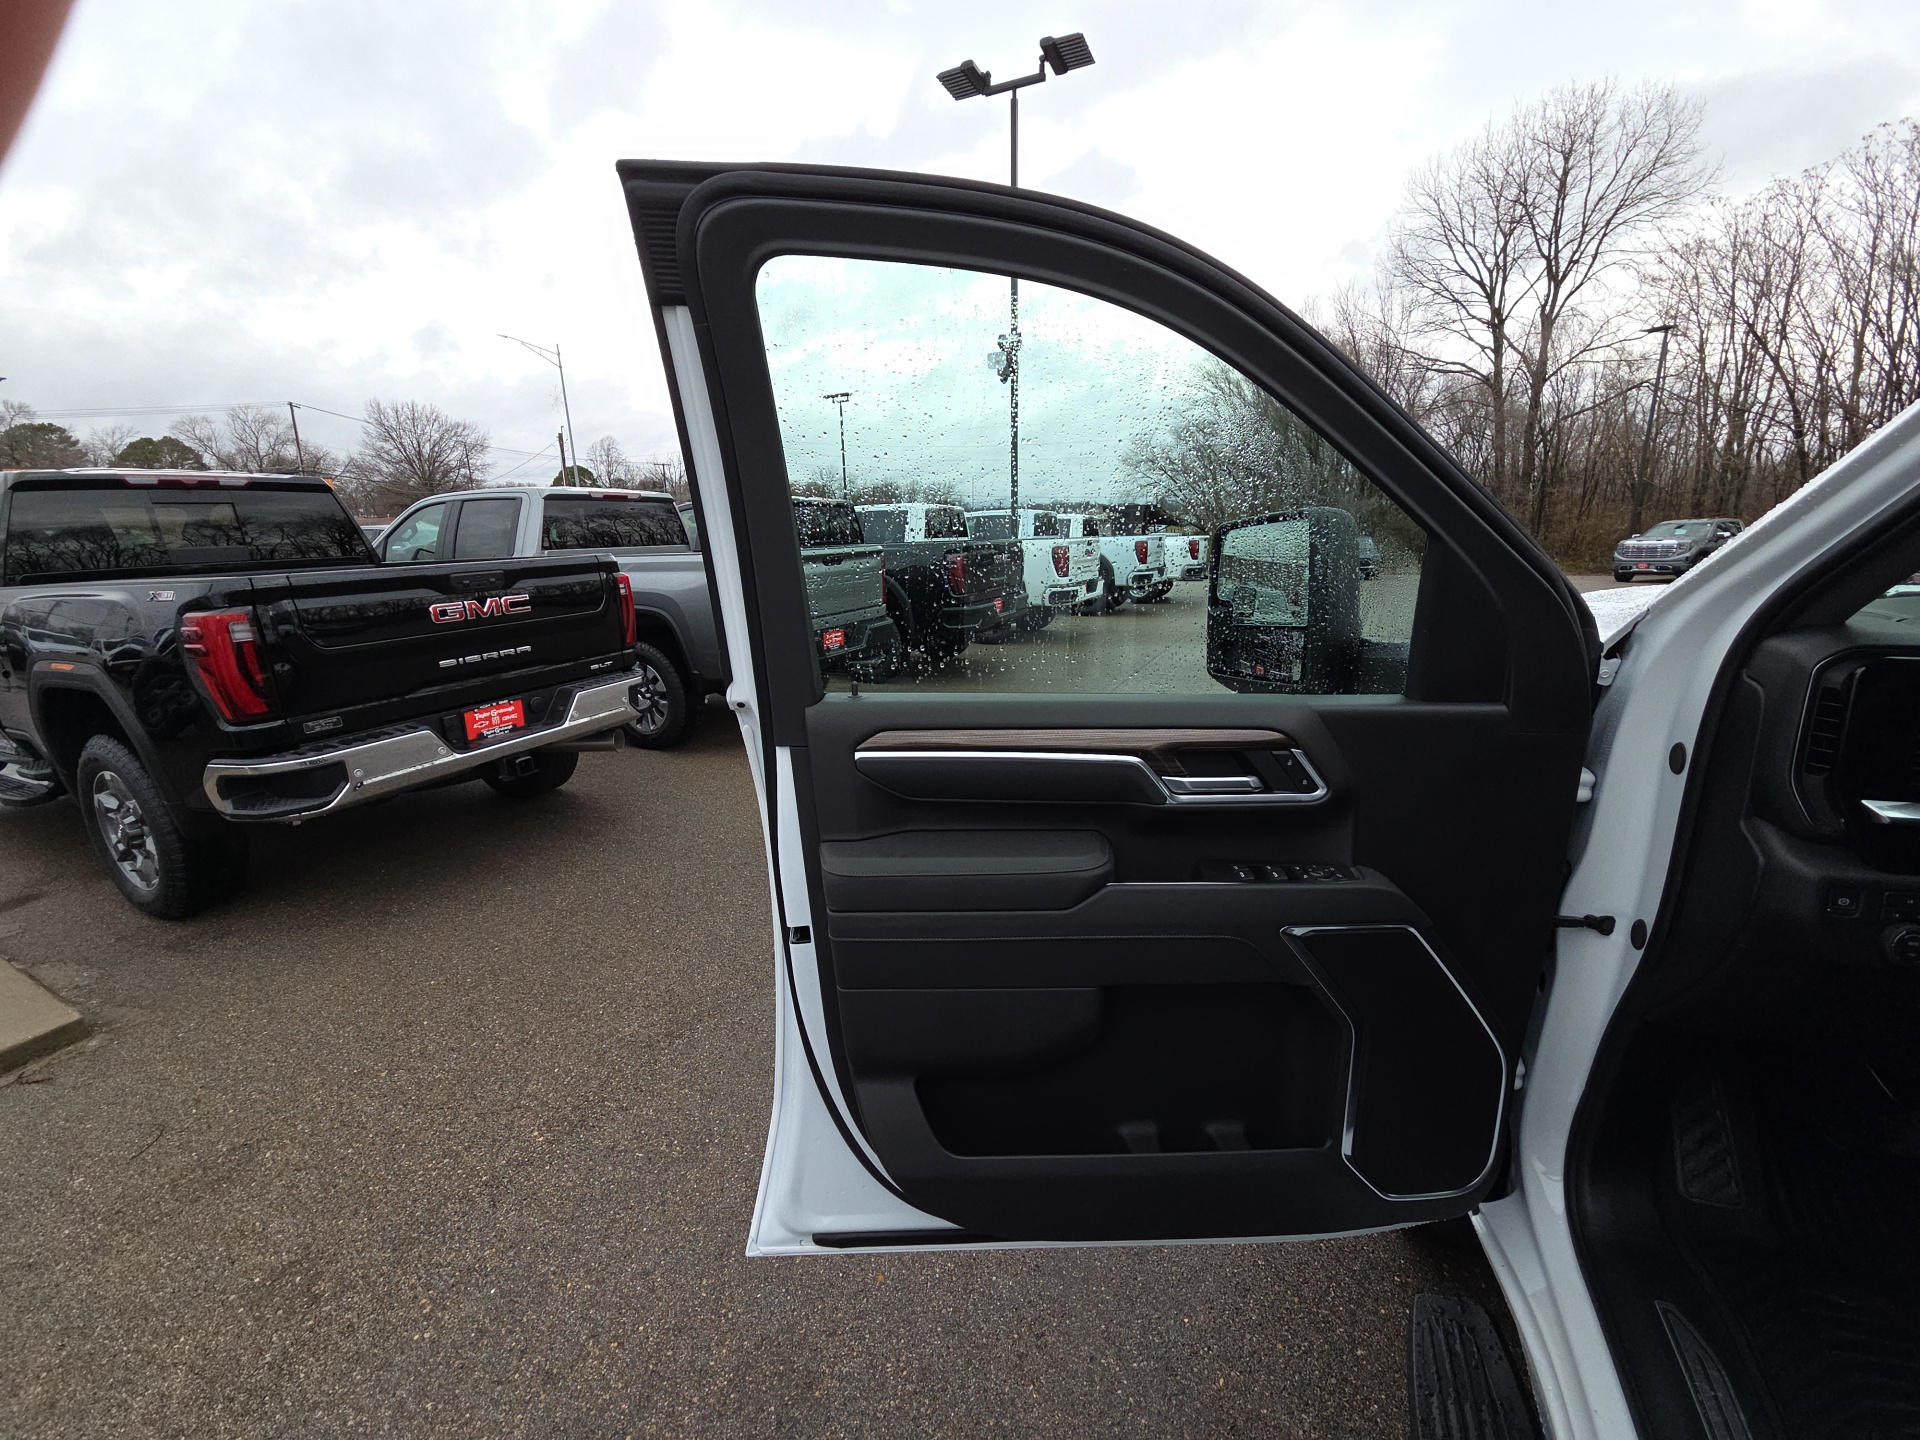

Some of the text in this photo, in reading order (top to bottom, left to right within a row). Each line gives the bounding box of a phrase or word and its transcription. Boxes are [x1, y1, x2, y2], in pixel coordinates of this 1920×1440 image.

[429, 594, 532, 623] GMC
[439, 645, 532, 668] SIERRA
[590, 661, 613, 670] SLT
[473, 711, 490, 721] Taylor
[501, 713, 518, 721] GMC
